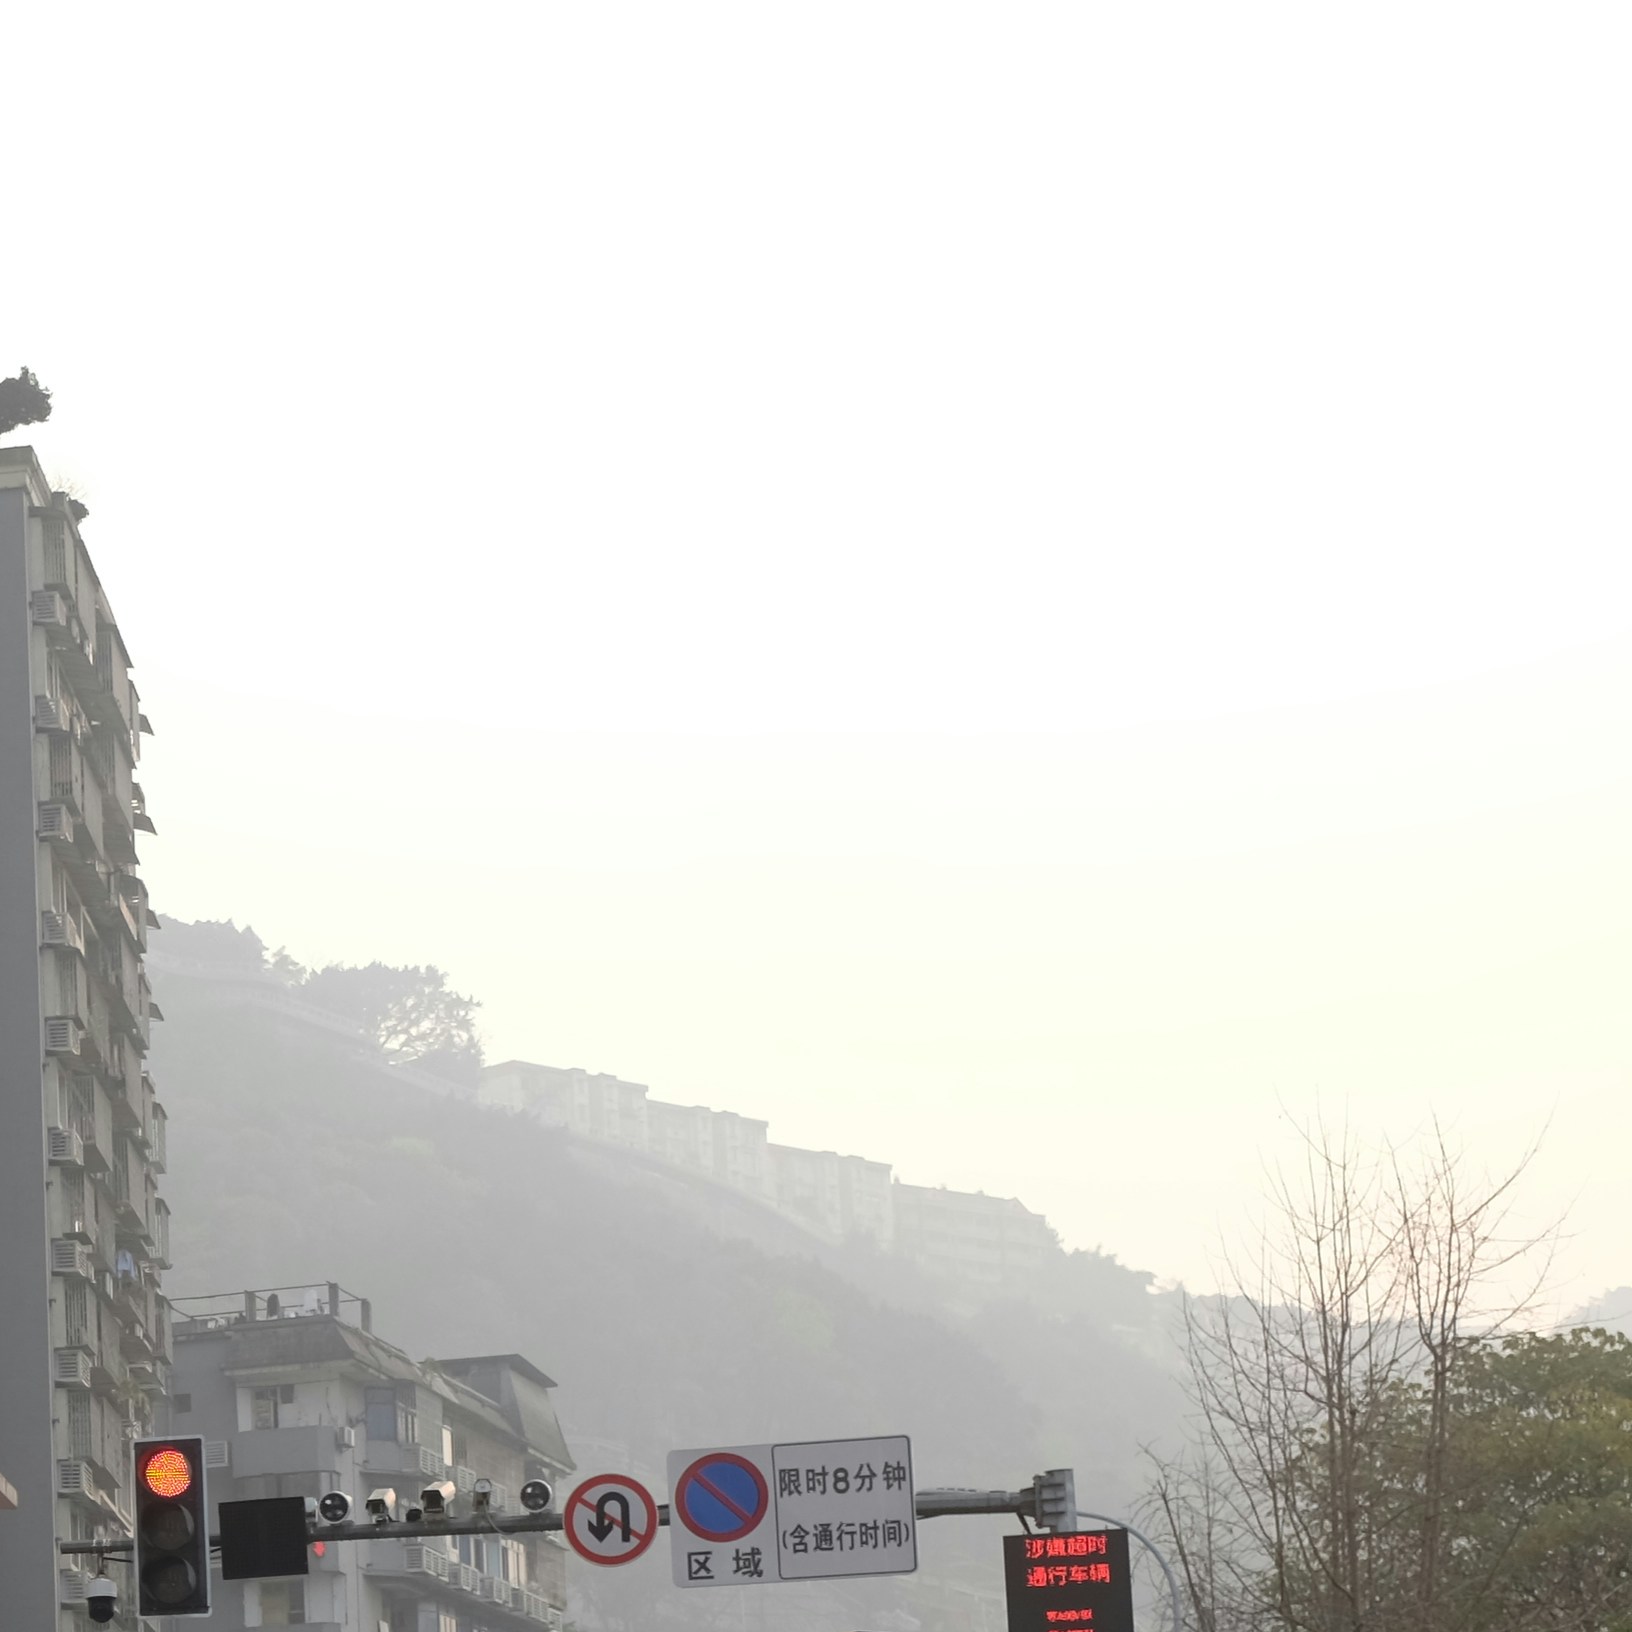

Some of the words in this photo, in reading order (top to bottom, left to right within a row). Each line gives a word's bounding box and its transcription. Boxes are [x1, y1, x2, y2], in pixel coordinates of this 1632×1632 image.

[778, 1460, 907, 1498] 限时8分钟
[782, 1520, 909, 1554] (含通行时间)
[687, 1547, 764, 1581] 区域
[1025, 1563, 1111, 1588] 通行车辆
